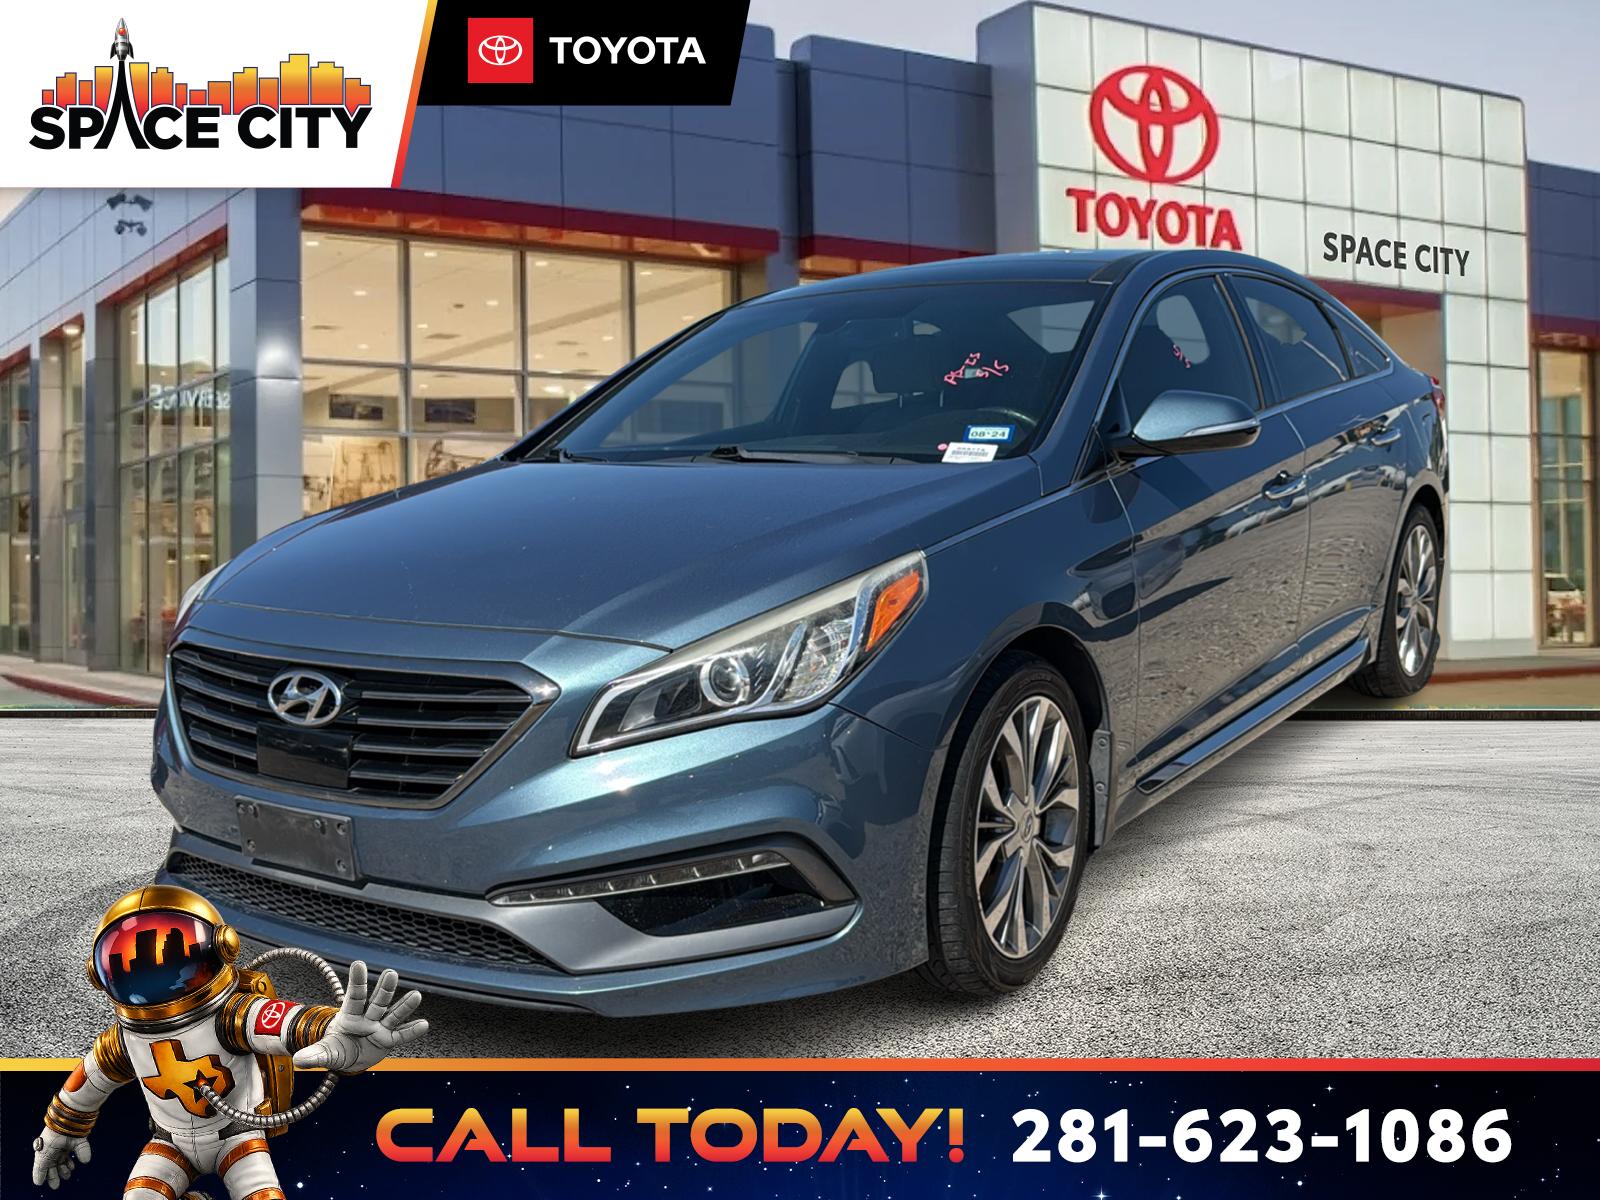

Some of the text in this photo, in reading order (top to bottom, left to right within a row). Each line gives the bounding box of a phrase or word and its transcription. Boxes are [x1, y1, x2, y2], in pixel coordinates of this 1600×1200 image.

[1066, 187, 1243, 251] TOYOTA
[1322, 231, 1471, 278] SPACE CITY
